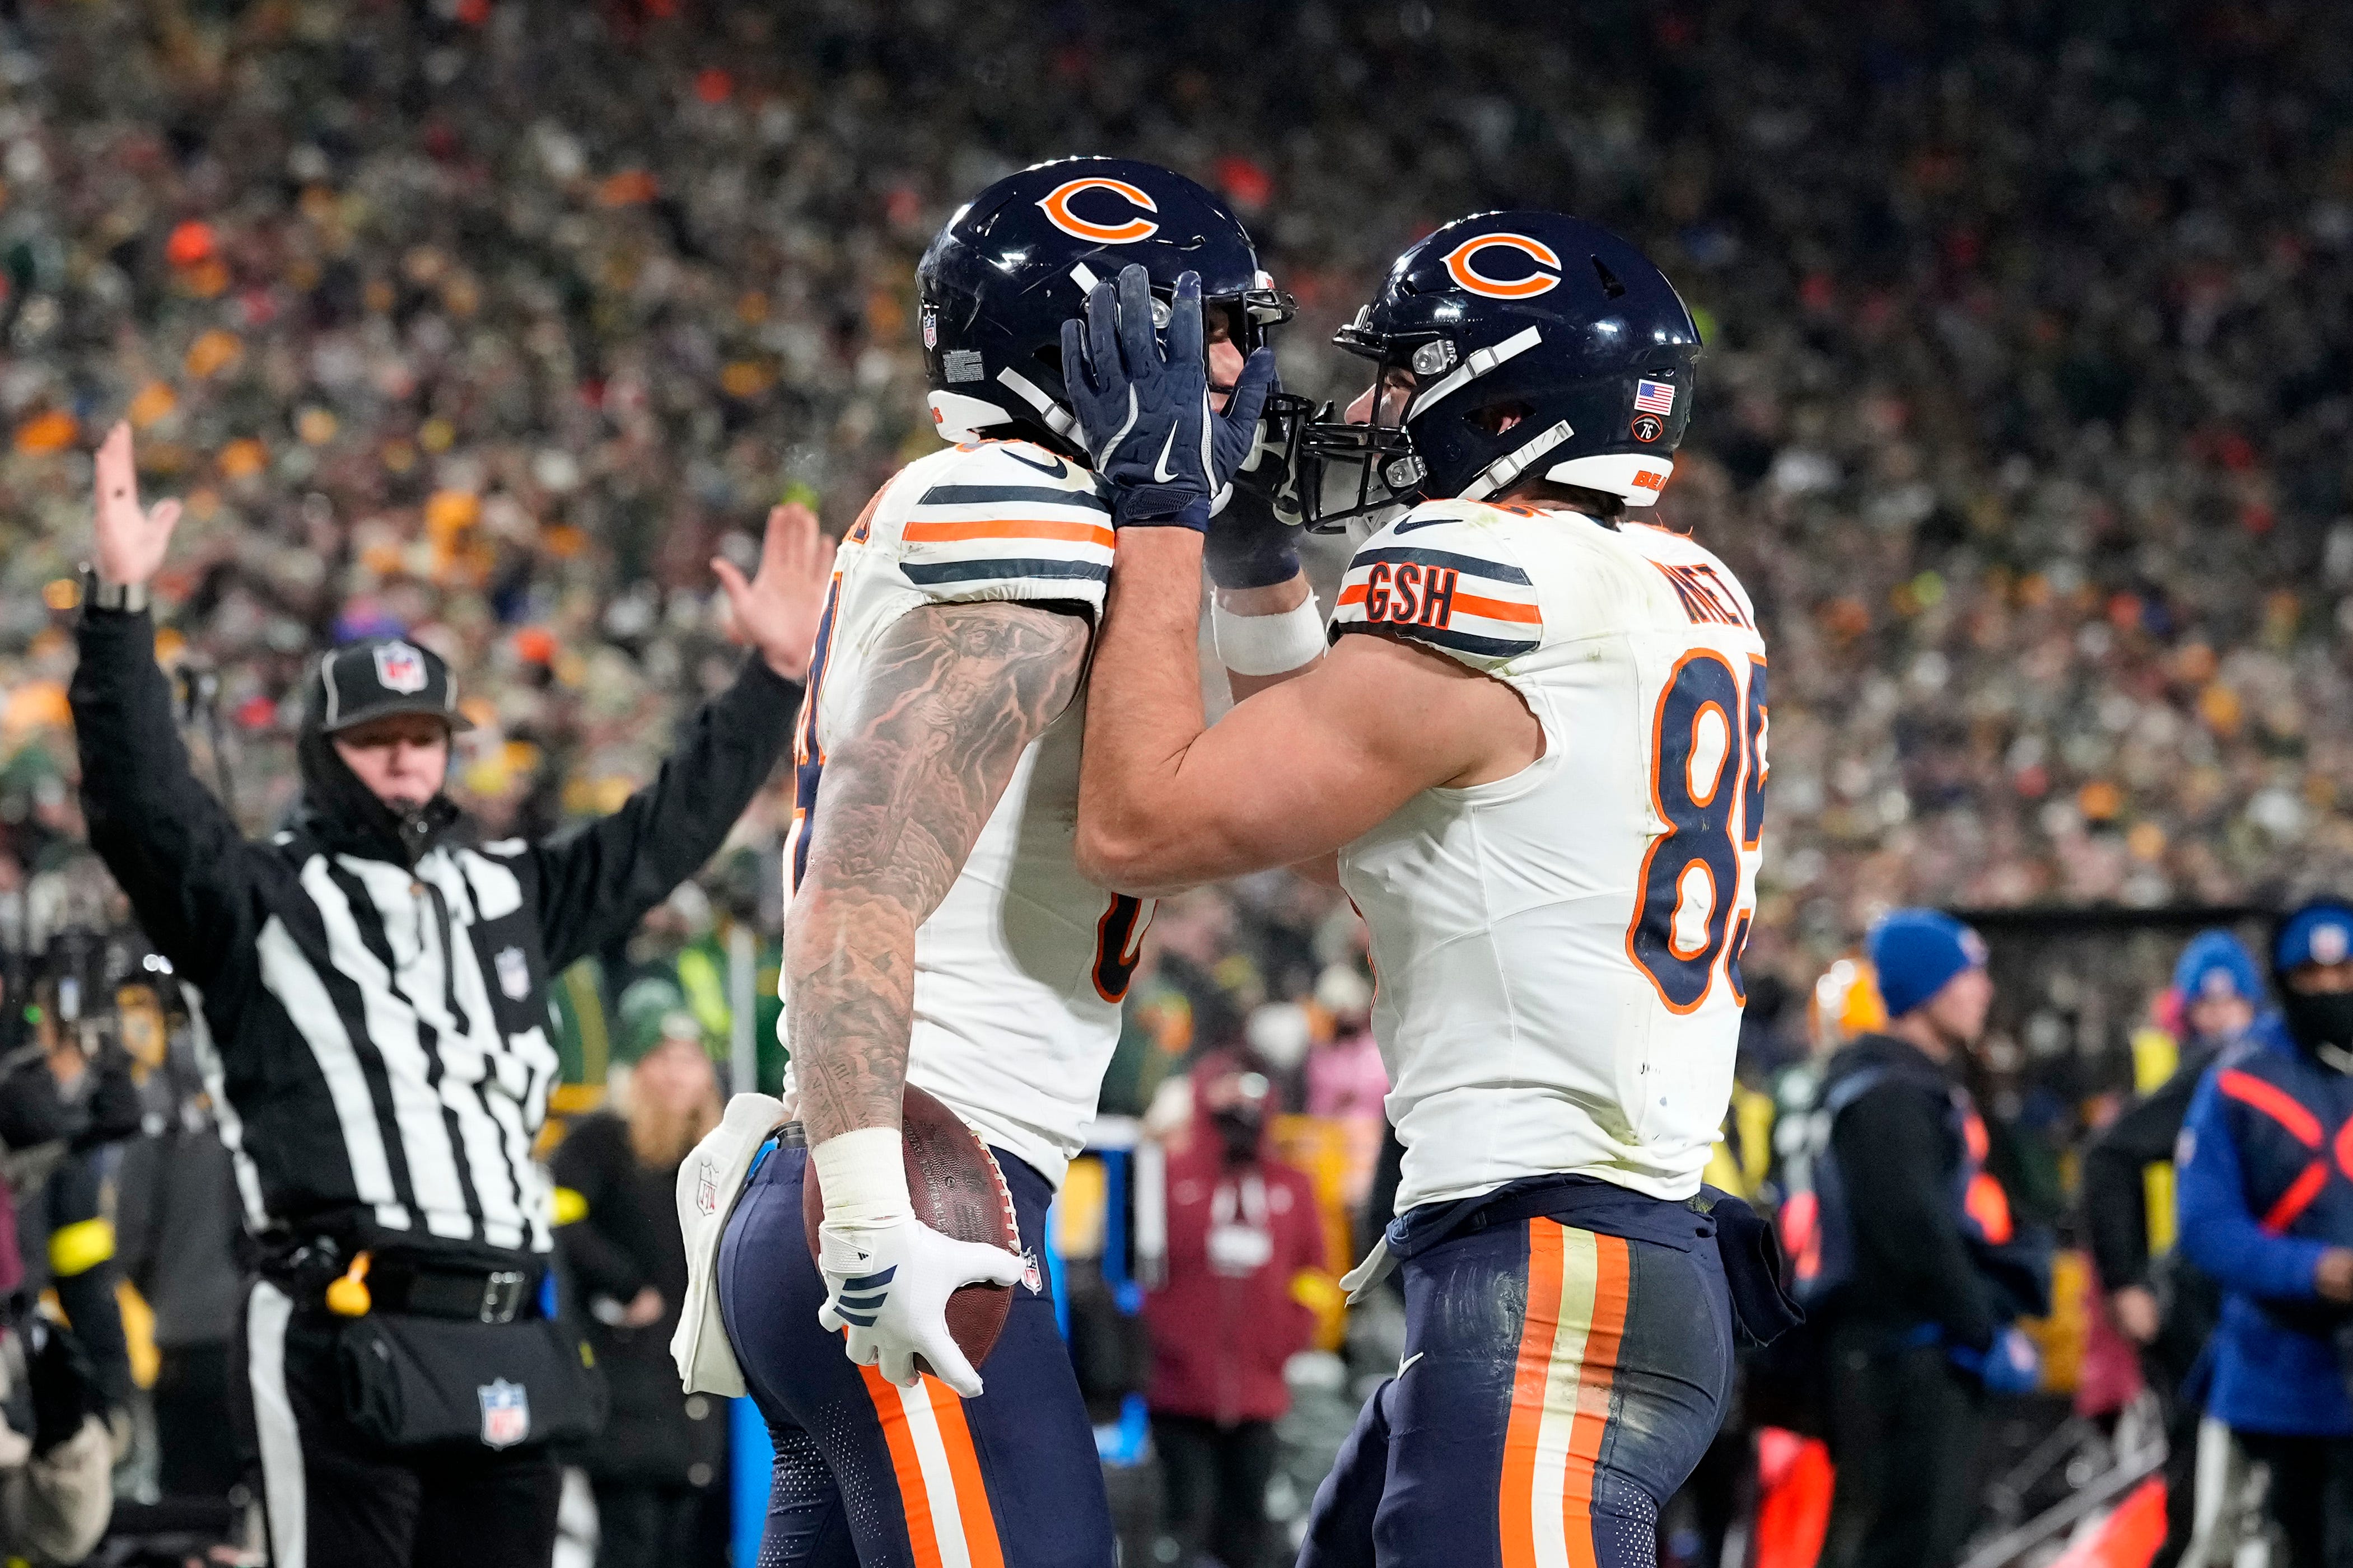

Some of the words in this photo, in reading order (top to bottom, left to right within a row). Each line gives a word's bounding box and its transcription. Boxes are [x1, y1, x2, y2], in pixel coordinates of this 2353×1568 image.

[1035, 177, 1159, 245] C
[1439, 233, 1561, 299] C
[1641, 423, 1653, 439] 76
[1365, 561, 1459, 630] GSH
